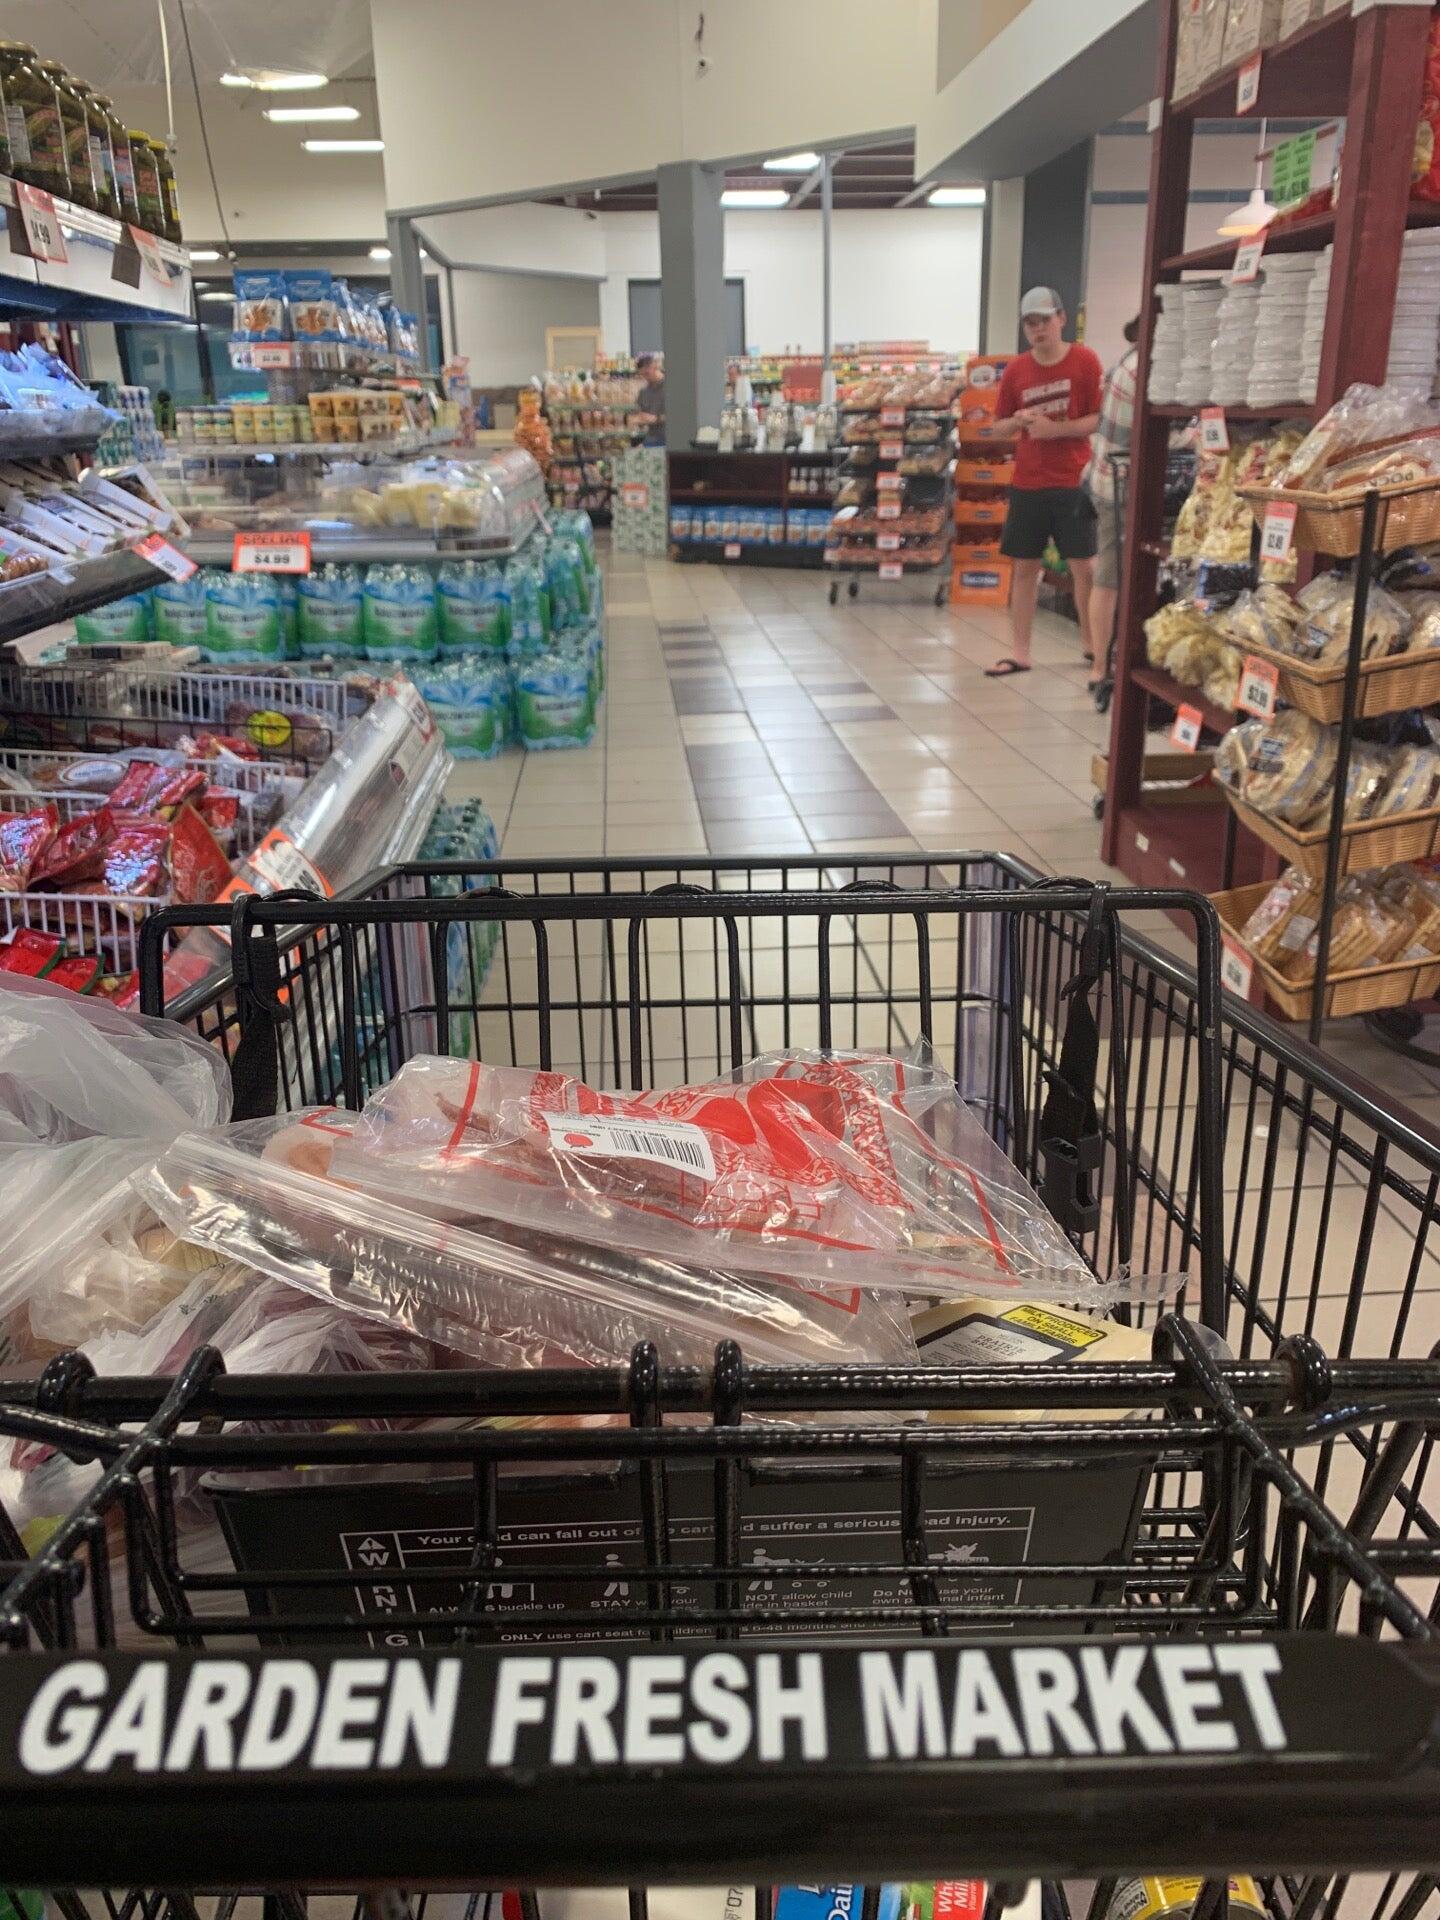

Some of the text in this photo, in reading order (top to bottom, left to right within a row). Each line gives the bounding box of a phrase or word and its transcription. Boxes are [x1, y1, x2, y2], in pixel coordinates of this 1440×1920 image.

[1023, 1306, 1099, 1338] MILK PRODUCED
[1026, 1315, 1074, 1338] ON SMALL
[418, 1535, 462, 1546] Your
[518, 1531, 550, 1542] can
[556, 1529, 583, 1540] fall
[588, 1528, 618, 1539] out
[623, 1527, 642, 1537] of
[681, 1524, 715, 1535] cart
[760, 1520, 815, 1531] suffer
[818, 1521, 829, 1530] a
[834, 1518, 901, 1529] serious
[956, 1514, 1012, 1528] injury.
[745, 1590, 854, 1602] NOT allow child
[873, 1589, 893, 1598] Do
[963, 1586, 994, 1597] your
[590, 1600, 631, 1609] STAY
[872, 1598, 901, 1606] own
[967, 1593, 1006, 1602] infant
[499, 1601, 543, 1612] buckle
[547, 1602, 565, 1612] up
[501, 1632, 543, 1641] ONLY
[547, 1632, 572, 1640] use
[576, 1630, 601, 1639] cart
[605, 1629, 634, 1638] seat
[18, 1643, 1288, 1776] GARDEN FRESH MARKET
